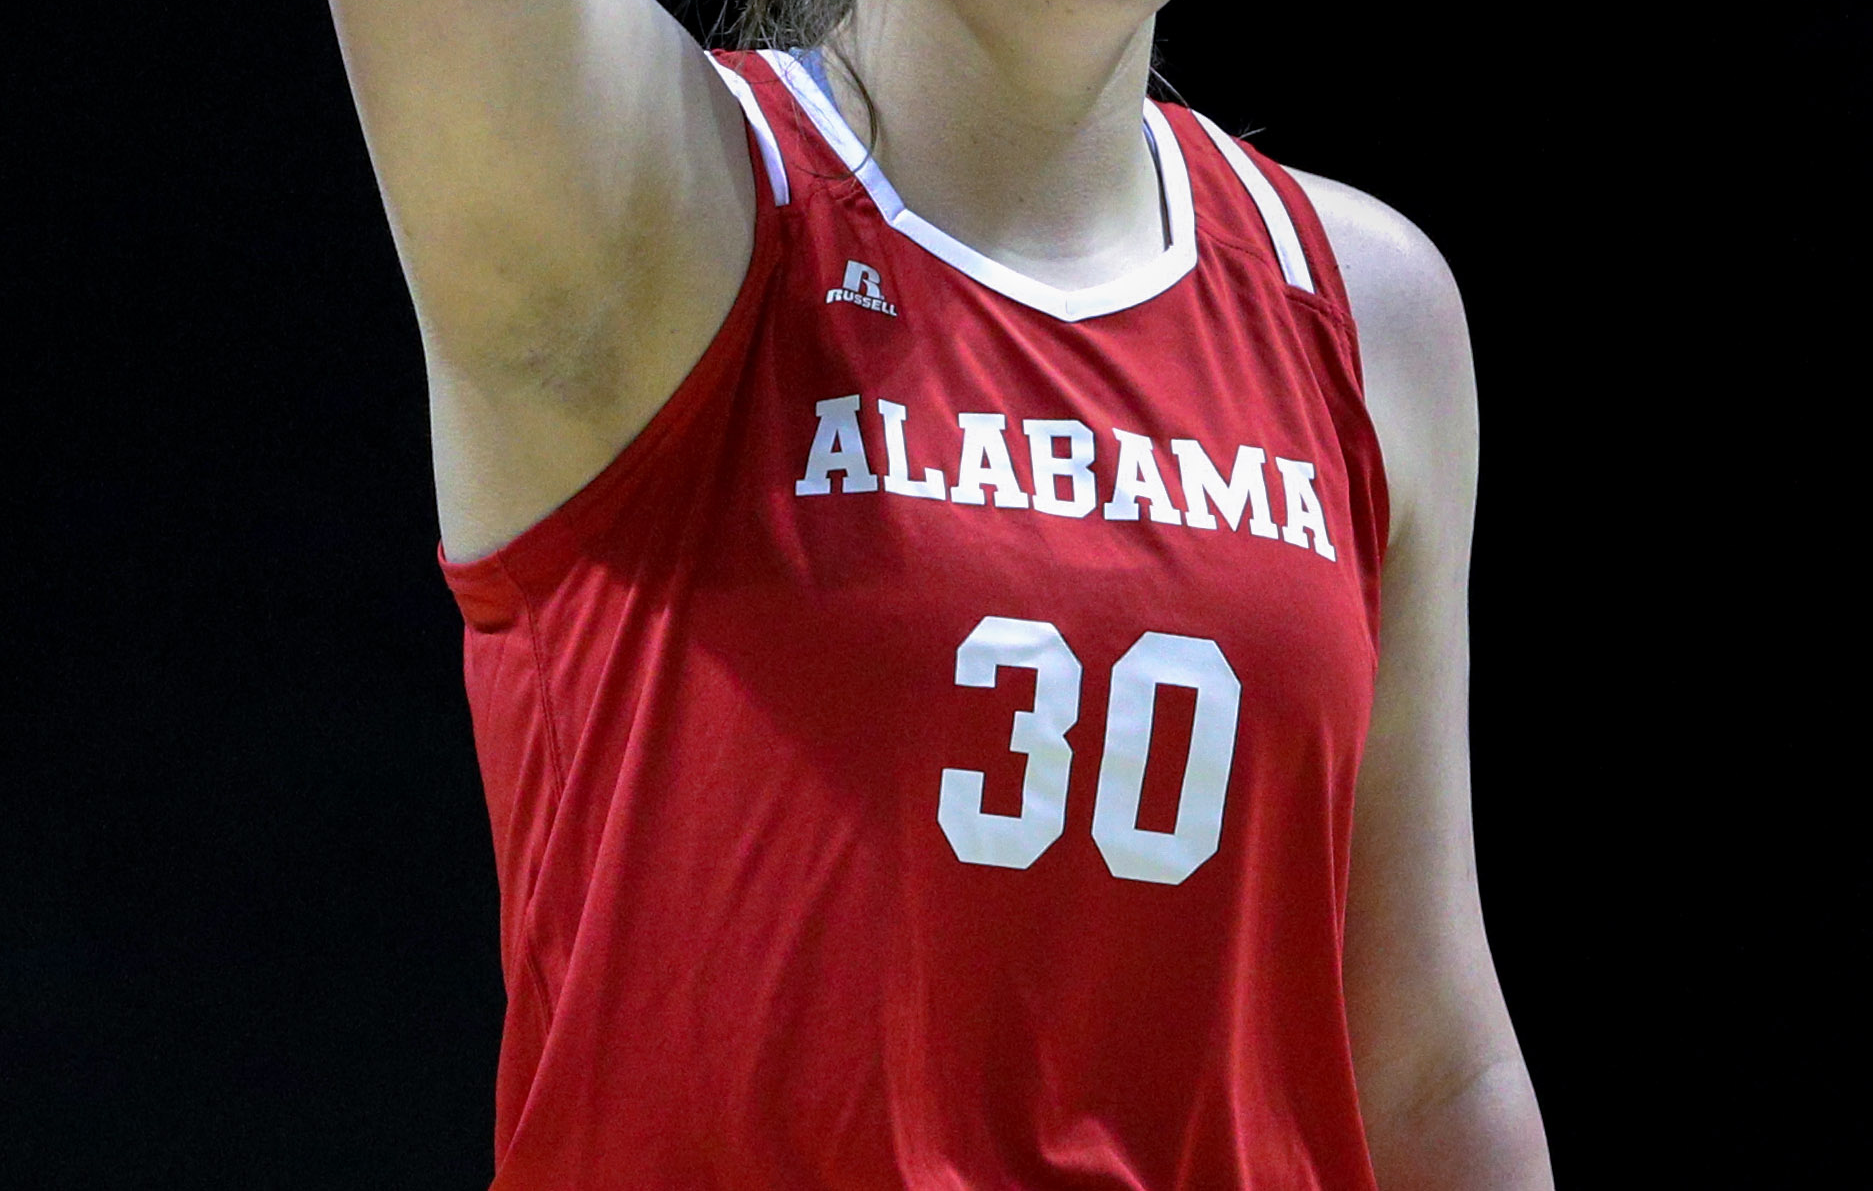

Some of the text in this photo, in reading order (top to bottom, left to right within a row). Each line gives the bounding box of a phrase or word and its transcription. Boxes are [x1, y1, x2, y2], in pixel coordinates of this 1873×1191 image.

[826, 289, 898, 317] RUSSELL
[842, 259, 882, 299] R
[795, 394, 1337, 563] ALABAMA
[937, 615, 1242, 886] 30
